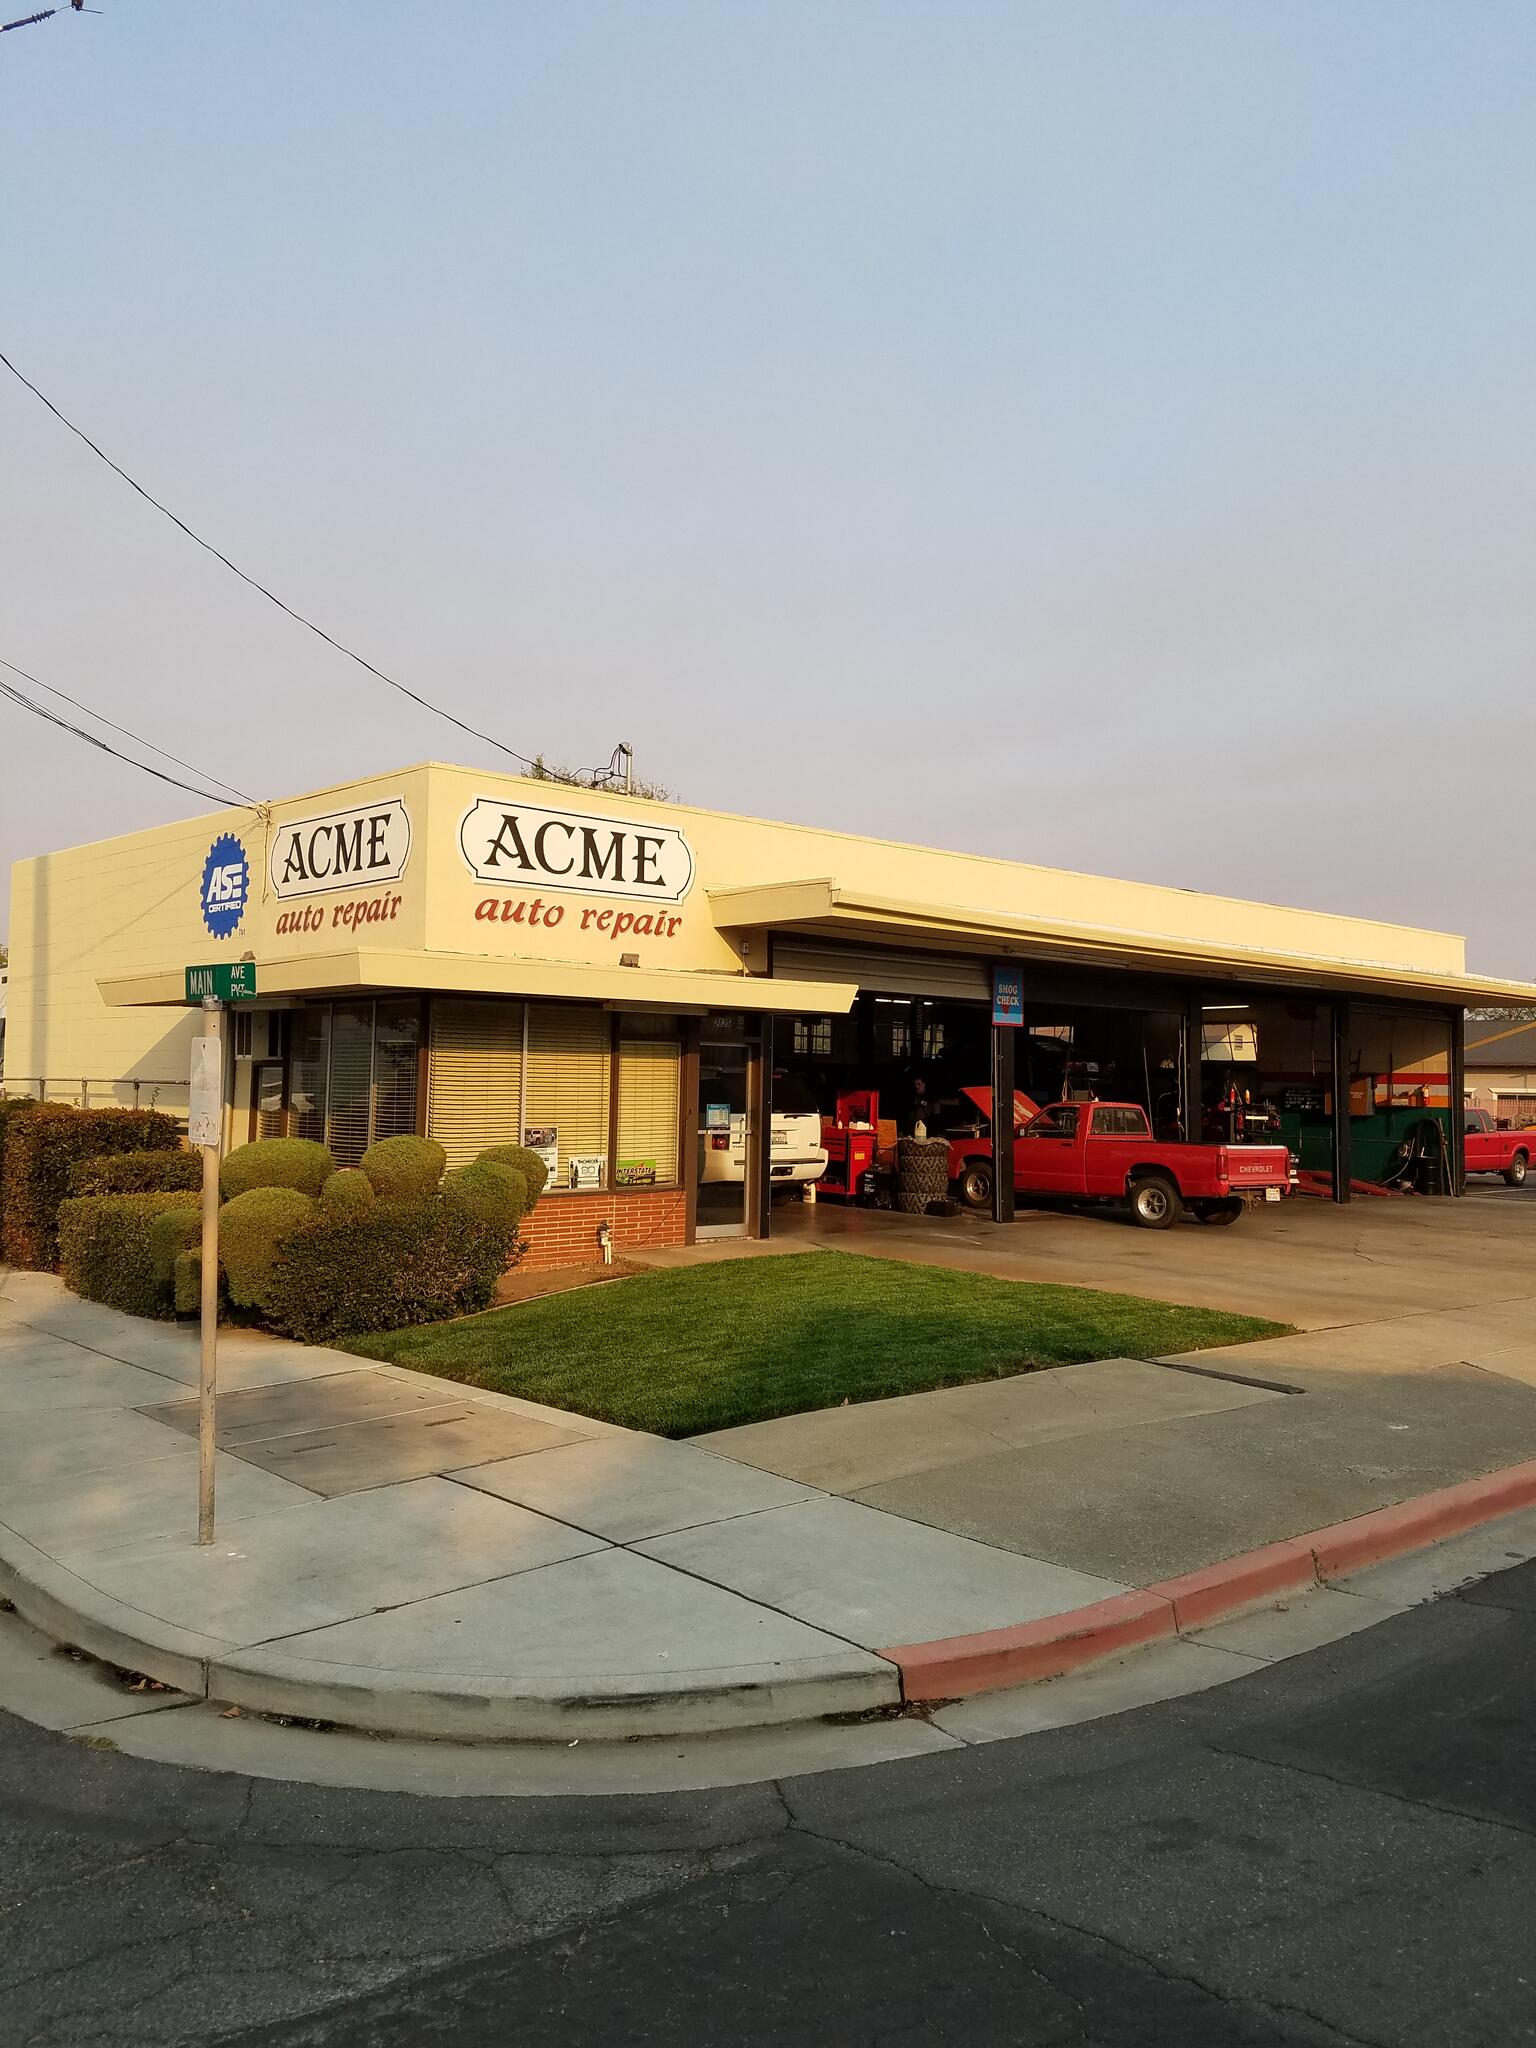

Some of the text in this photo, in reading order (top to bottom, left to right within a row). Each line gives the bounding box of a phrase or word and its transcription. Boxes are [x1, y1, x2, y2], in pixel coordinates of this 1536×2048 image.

[281, 813, 392, 883] ACME
[483, 814, 667, 887] ACME
[206, 863, 243, 903] ASE
[208, 900, 242, 913] CERTIFIED
[275, 891, 402, 935] auto repair
[474, 898, 683, 940] auto repair
[230, 965, 246, 979] AVE
[190, 970, 213, 995] MAIN
[998, 984, 1018, 995] SMOG
[996, 995, 1020, 1006] CHECK
[616, 1167, 651, 1175] INTERSTATE
[1239, 1165, 1273, 1173] CHEVROLET
